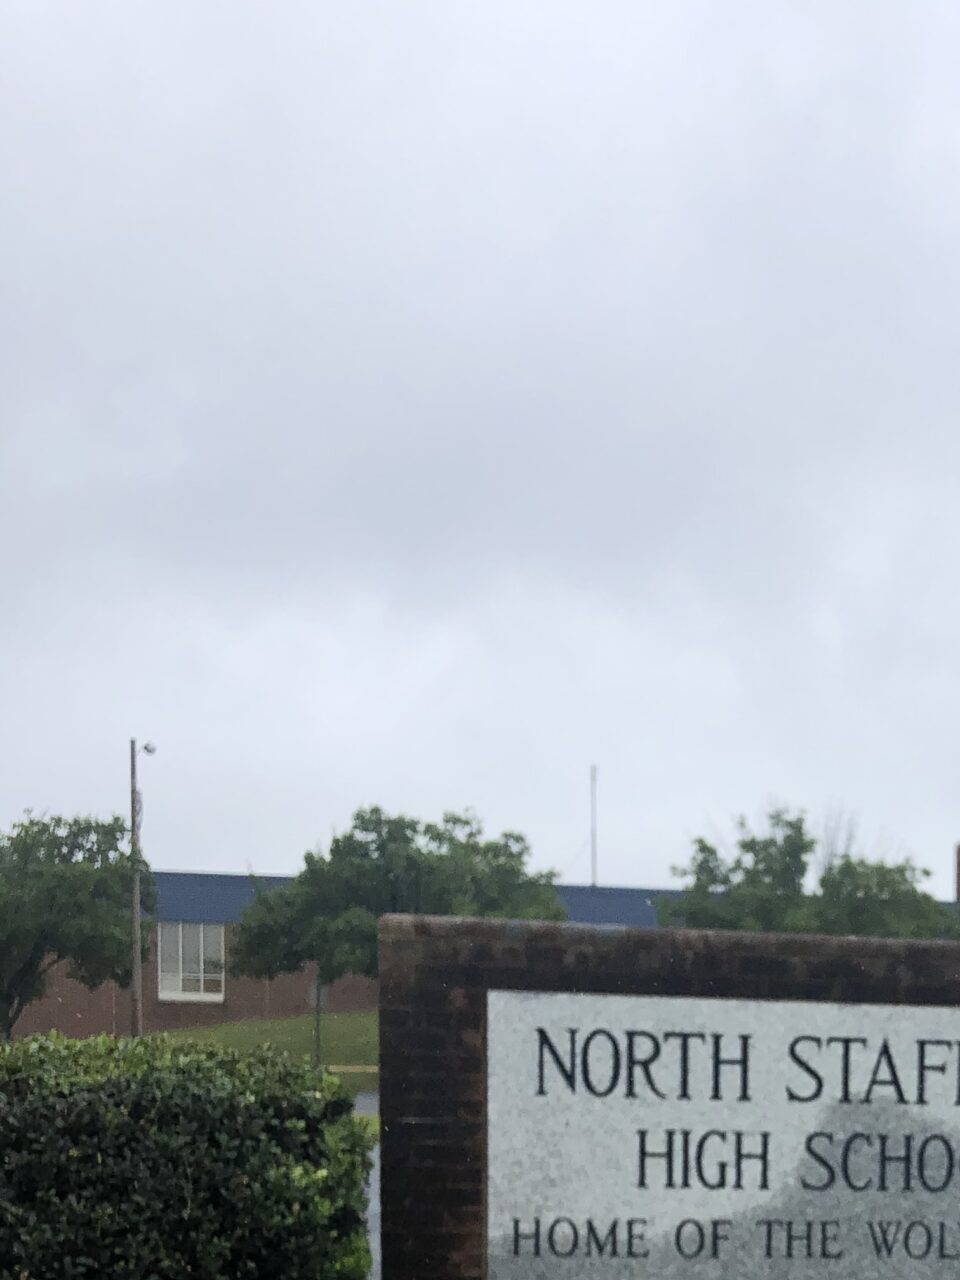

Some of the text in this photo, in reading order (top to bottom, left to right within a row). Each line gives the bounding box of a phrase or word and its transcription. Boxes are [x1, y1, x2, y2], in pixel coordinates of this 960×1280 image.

[535, 1027, 752, 1101] NORTH
[636, 1129, 771, 1191] HIGH
[512, 1217, 650, 1260] HOME
[675, 1218, 732, 1260] OF
[756, 1219, 844, 1260] THE
